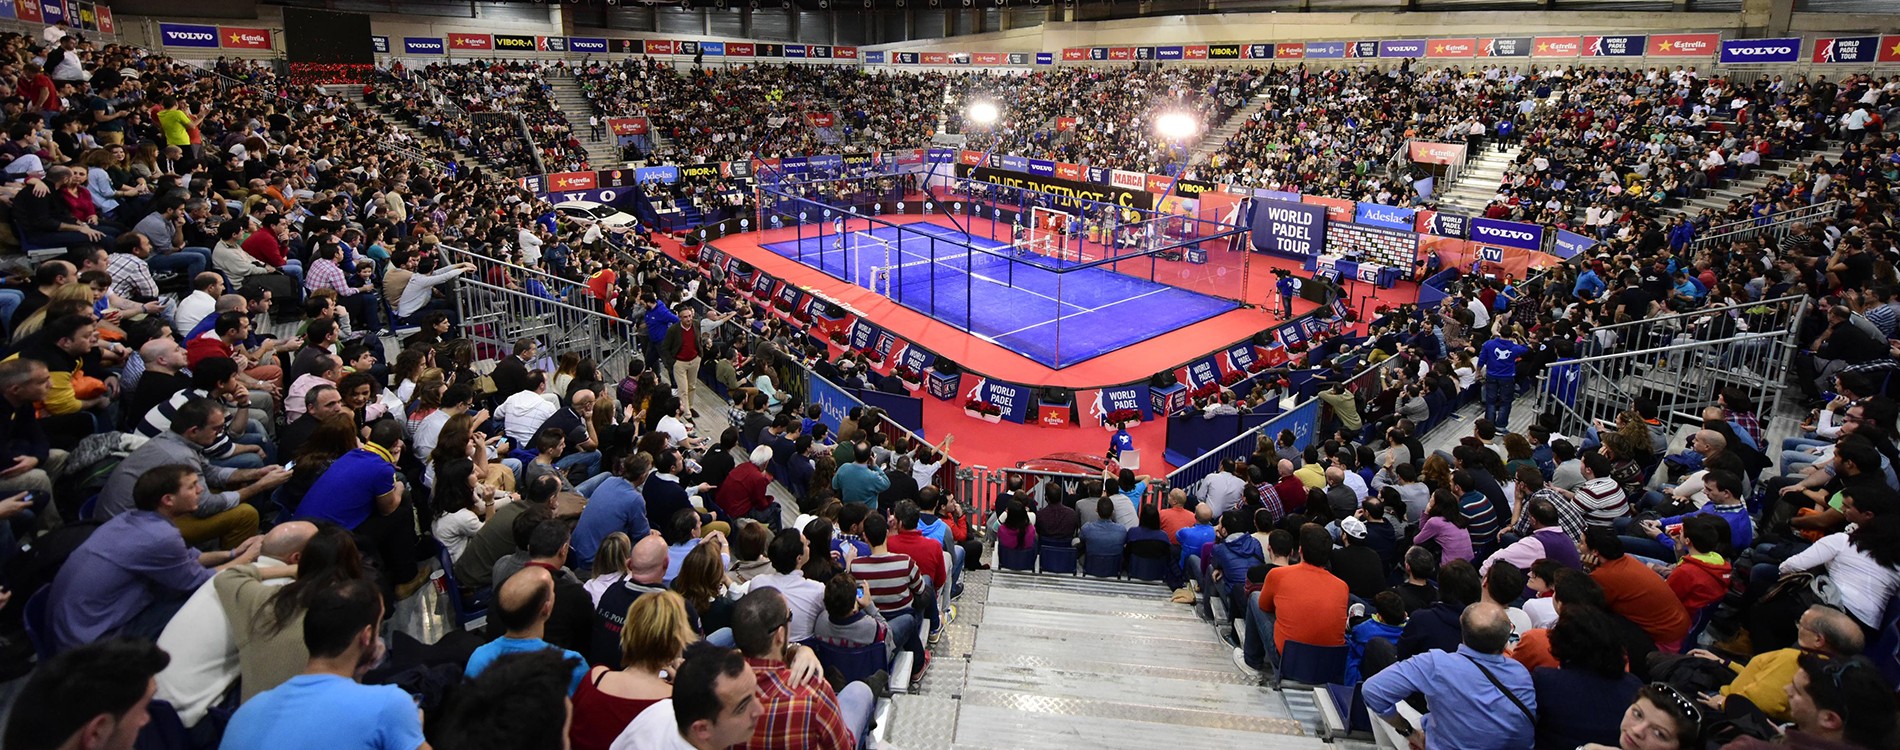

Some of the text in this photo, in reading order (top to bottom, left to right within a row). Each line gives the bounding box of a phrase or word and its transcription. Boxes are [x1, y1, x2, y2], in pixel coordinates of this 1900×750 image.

[167, 31, 213, 40] VOLVO
[241, 34, 265, 42] Estrella
[496, 38, 533, 47] VIBOR-A
[1210, 48, 1238, 56] VIBOR-A
[1728, 47, 1791, 55] VOLVO
[1429, 149, 1456, 157] Estrella
[843, 156, 871, 164] VIBOR-A
[682, 167, 718, 176] VIBOR-A
[1031, 164, 1053, 172] VOLVO
[643, 170, 673, 180] Adeslas
[1114, 173, 1143, 187] MARCA
[567, 177, 591, 185] Estrella
[1268, 207, 1312, 225] WORLD
[1364, 209, 1404, 224] Adeslas
[1441, 216, 1463, 224] WORLD
[1442, 222, 1461, 230] PADEL
[1272, 222, 1311, 241] PADEL
[1444, 228, 1461, 236] TOUR
[1477, 226, 1534, 241] VOLVO
[1277, 237, 1310, 255] TOUR
[1556, 239, 1574, 250] PHILIPS
[1486, 249, 1500, 259] TV
[858, 323, 872, 334] WORLD
[856, 330, 868, 342] PADEL
[855, 338, 866, 348] TOUR
[909, 349, 926, 362] WORLD
[1232, 347, 1248, 358] WORLD
[907, 357, 921, 370] PADEL
[1237, 355, 1251, 365] PADEL
[1193, 362, 1210, 374] WORLD
[1198, 370, 1213, 382] PADEL
[990, 383, 1016, 397] WORLD
[1109, 390, 1136, 400] WORLD
[990, 394, 1013, 407] PADEL
[1114, 400, 1138, 410] PADEL
[1043, 416, 1063, 424] Estrella
